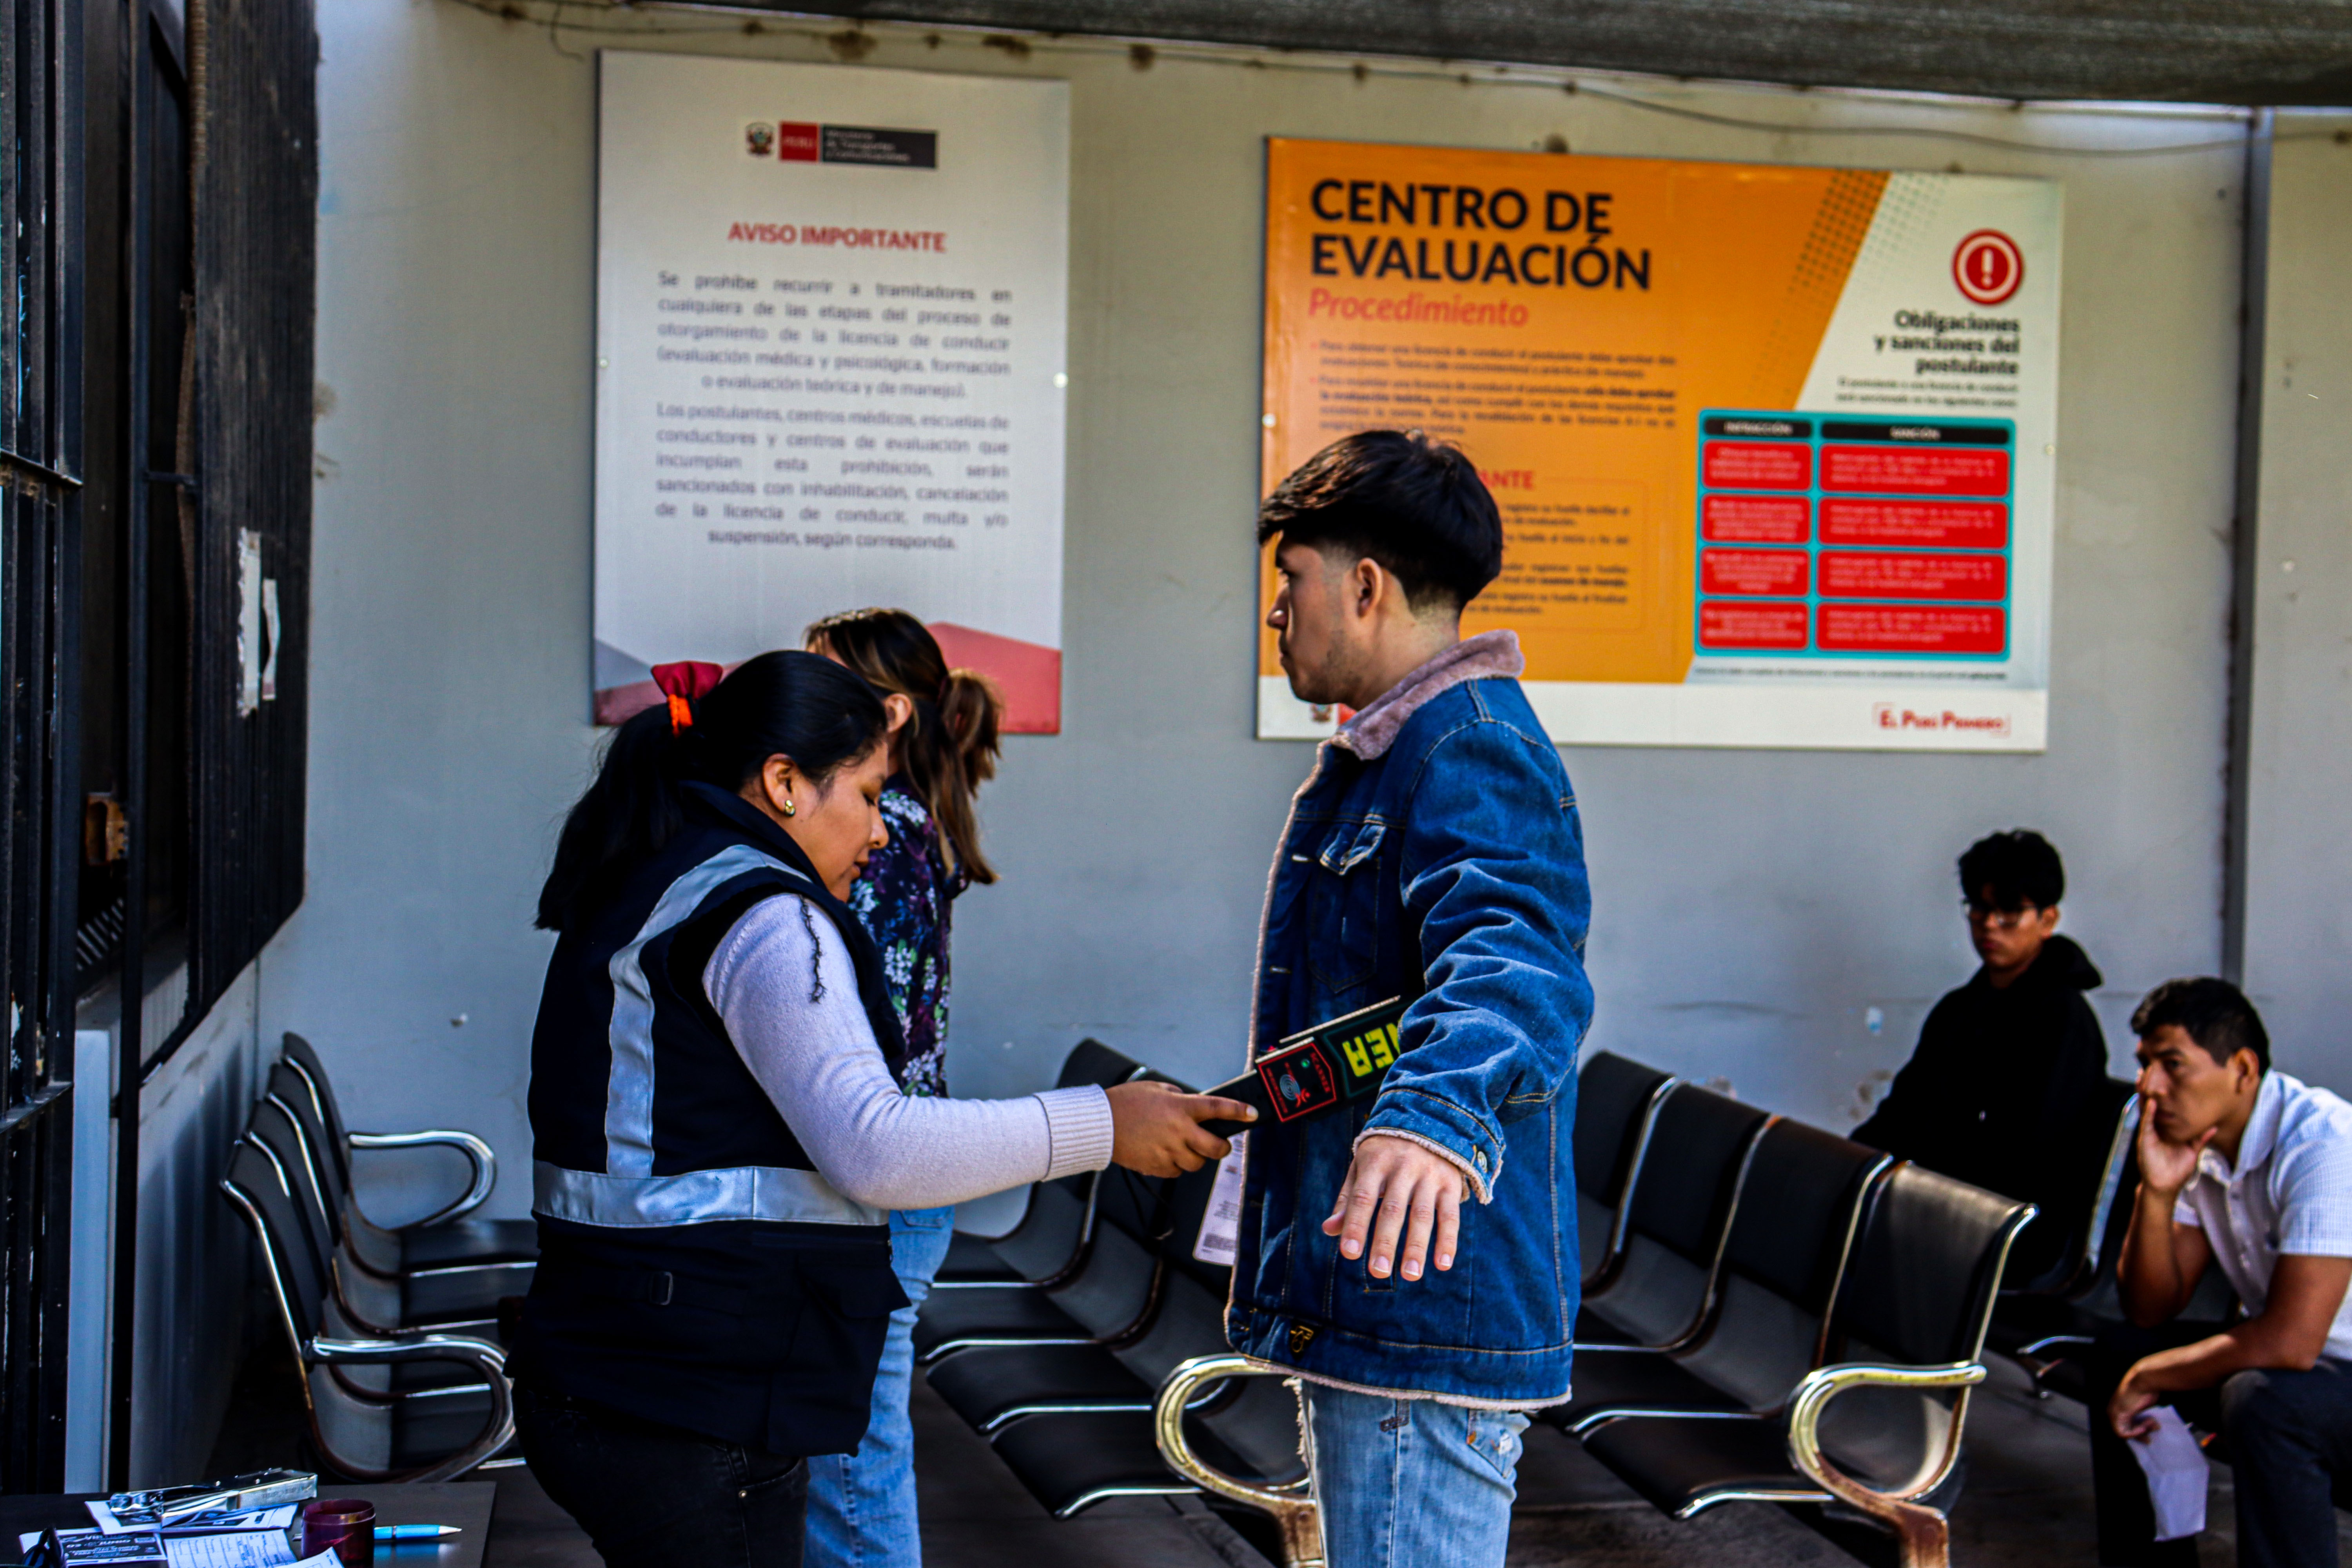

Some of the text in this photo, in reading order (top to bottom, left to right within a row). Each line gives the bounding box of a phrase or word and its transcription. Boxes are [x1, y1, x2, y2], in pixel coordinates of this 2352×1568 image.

[1310, 178, 1612, 235] CENTRO DE
[728, 220, 947, 253] AVISO IMPORTANTE
[1312, 232, 1650, 290] EVALUACIÓN
[658, 271, 679, 288] Se
[695, 273, 758, 293] prohibe
[773, 277, 835, 295] recurrir
[874, 281, 976, 302] tramitadores
[991, 289, 1012, 304] en
[658, 297, 1012, 328] cualquiera de las etapas del proceso de
[1308, 288, 1530, 327] Procedimiento
[657, 322, 1011, 352] otorgamiento de la licencia de conducir
[1894, 310, 2020, 336] Obligaciones
[1875, 336, 2020, 354] y sanciones del
[755, 350, 814, 368] médica
[931, 358, 1011, 377] formación
[1915, 356, 2018, 376] postulante
[716, 374, 803, 393] evaluación
[876, 380, 897, 396] de
[656, 401, 686, 419] Los
[786, 408, 846, 425] centros
[920, 413, 987, 431] escuelas
[989, 415, 1010, 431] de
[656, 427, 758, 447] conductores
[786, 433, 847, 450] centros
[855, 434, 876, 451] de
[886, 436, 970, 454] evaluación
[979, 441, 1010, 457] que
[657, 452, 742, 472] incumplan
[774, 456, 808, 473] esta
[965, 463, 1009, 480] serán
[656, 477, 757, 496] sancionados
[763, 481, 794, 497] con
[916, 485, 1009, 505] cancelación
[654, 501, 677, 518] de
[692, 503, 708, 519] la
[724, 503, 784, 522] licencia
[799, 506, 820, 523] de
[924, 510, 969, 526] multa
[804, 530, 853, 550] según
